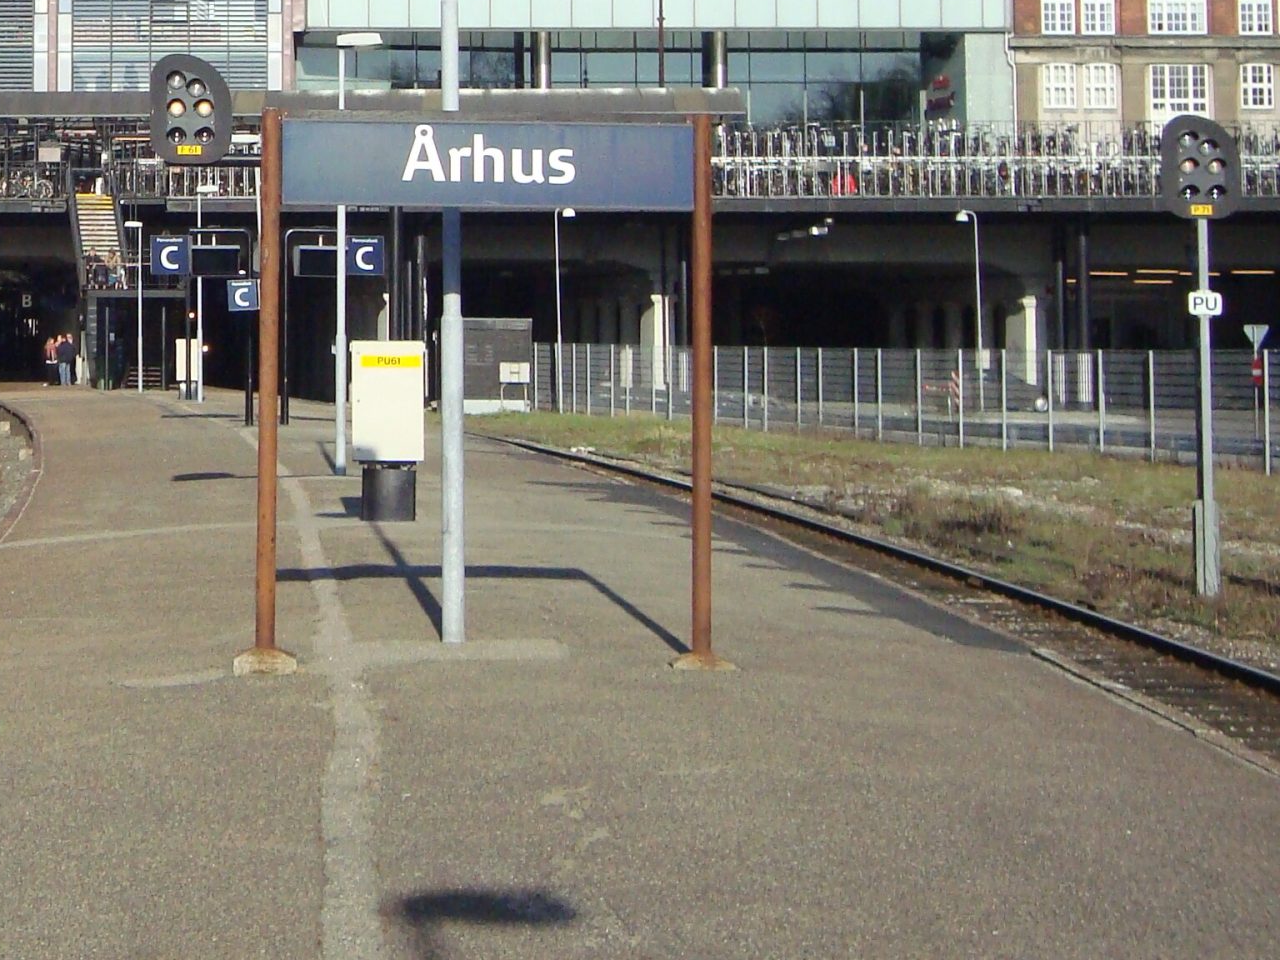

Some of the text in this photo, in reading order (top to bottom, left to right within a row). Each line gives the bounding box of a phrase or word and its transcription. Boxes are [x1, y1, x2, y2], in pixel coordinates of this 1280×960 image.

[402, 124, 576, 185] Århus
[160, 245, 180, 270] C
[355, 246, 375, 271] C
[234, 287, 250, 307] C
[1193, 296, 1218, 311] PU
[377, 356, 401, 365] PU61
